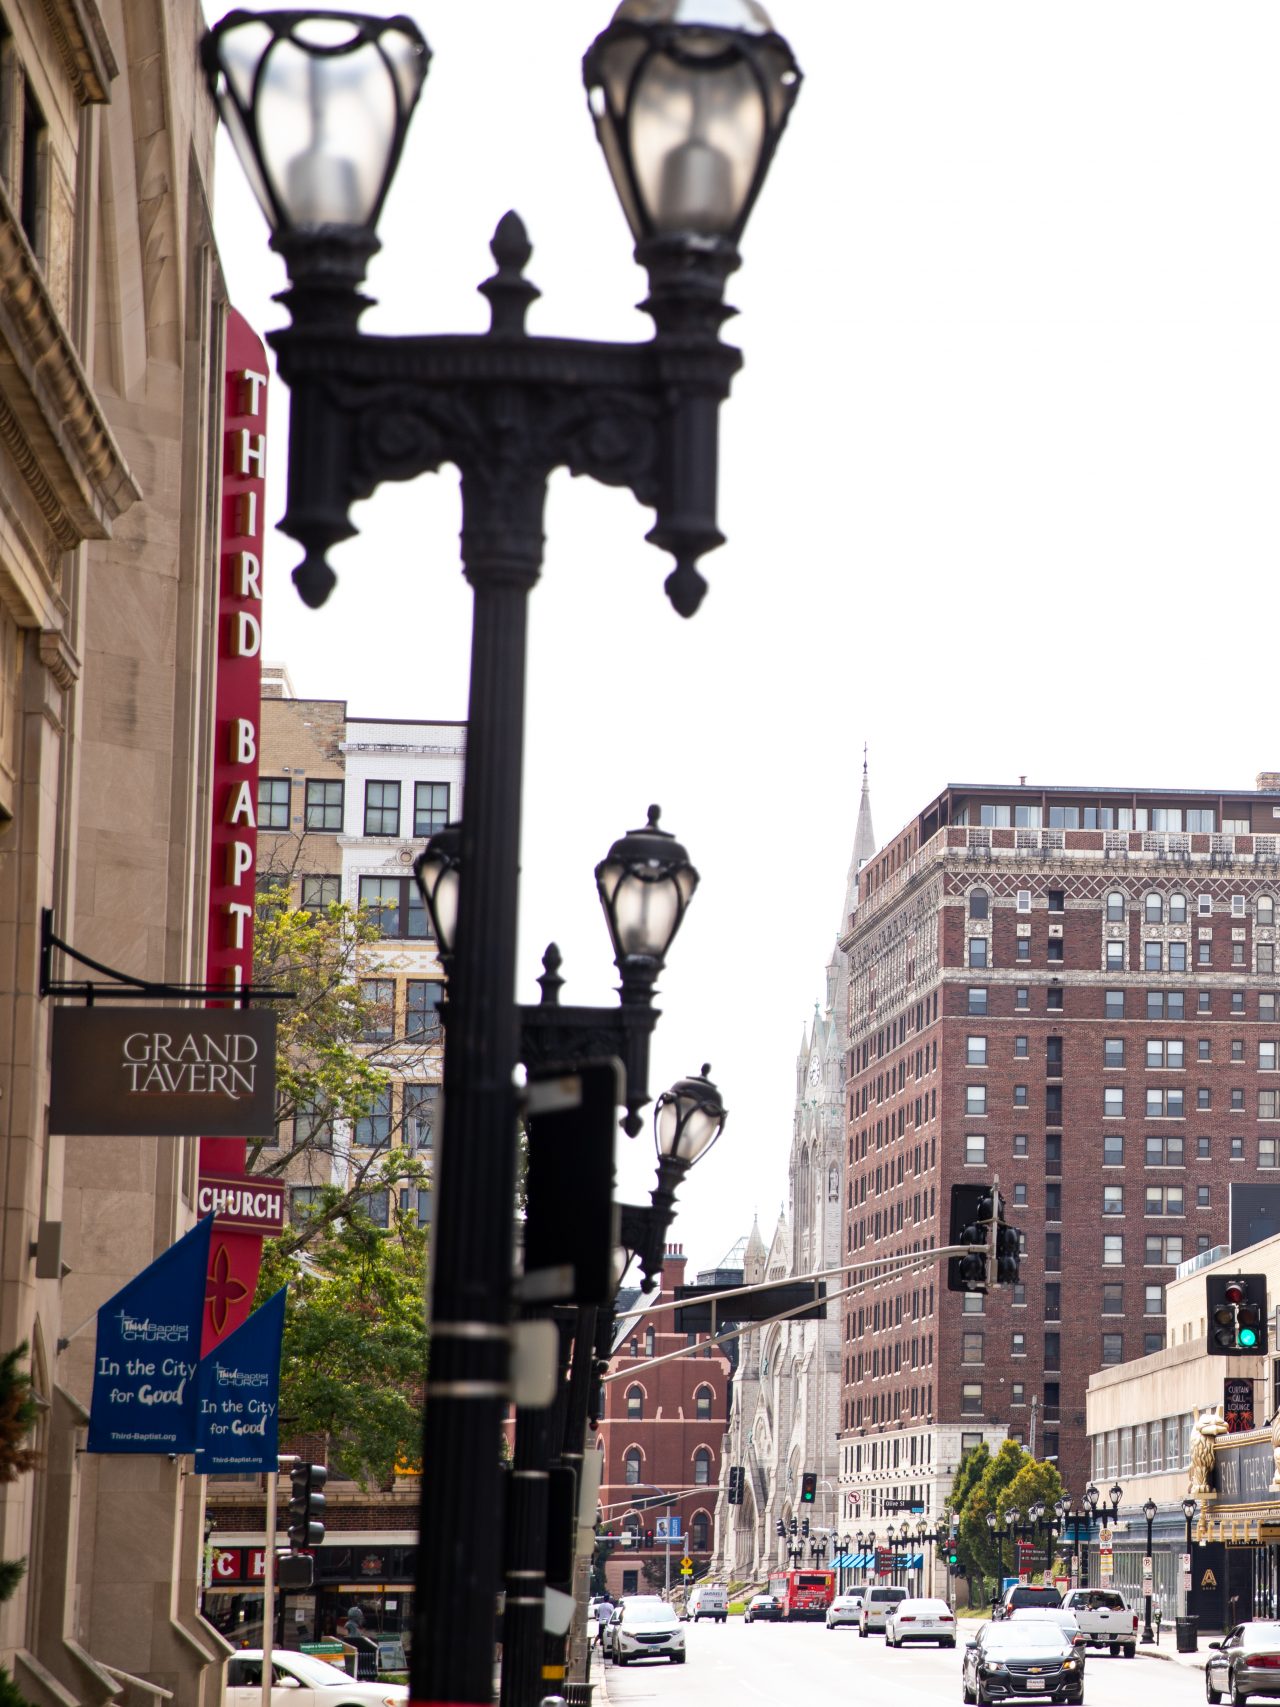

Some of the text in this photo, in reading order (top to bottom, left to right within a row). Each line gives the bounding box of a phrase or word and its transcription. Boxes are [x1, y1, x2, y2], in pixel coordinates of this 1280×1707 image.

[238, 368, 267, 657] THIRD
[230, 718, 257, 1008] BAPTI
[123, 1032, 258, 1063] GRAND
[122, 1063, 257, 1100] TAVERN
[199, 1187, 280, 1219] CHURCH
[123, 1331, 189, 1341] CHURCH
[148, 1323, 189, 1333] Baptist
[98, 1357, 197, 1381] In the City
[218, 1379, 269, 1387] CHURCH
[110, 1378, 186, 1406] for Good
[201, 1399, 276, 1416] In the City
[111, 1432, 177, 1441] Third-Baptist.org
[210, 1414, 267, 1436] for Good
[1221, 1461, 1238, 1495] FOX
[1243, 1455, 1274, 1493] THEAT
